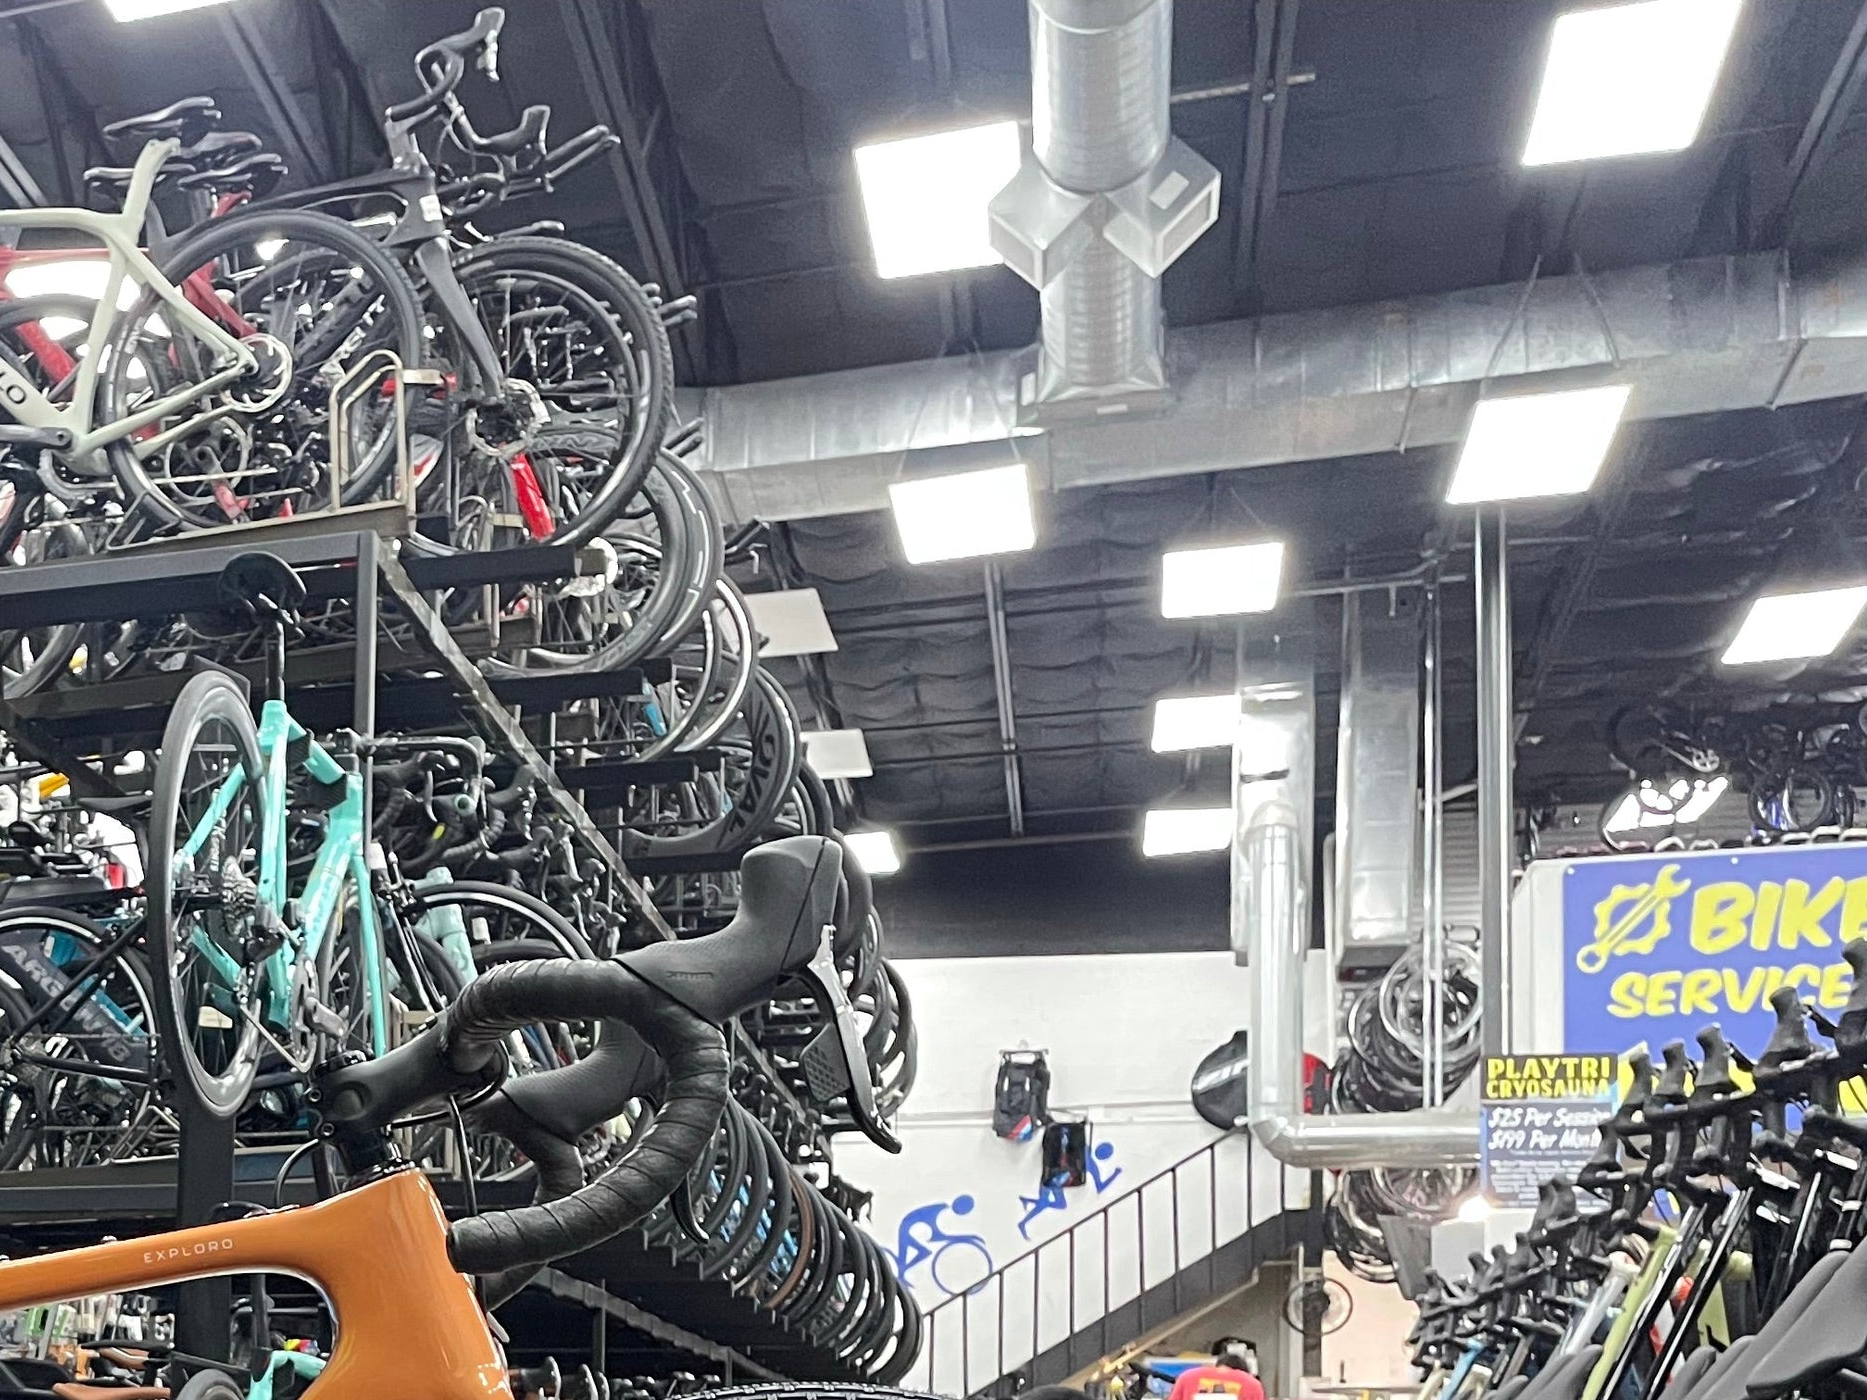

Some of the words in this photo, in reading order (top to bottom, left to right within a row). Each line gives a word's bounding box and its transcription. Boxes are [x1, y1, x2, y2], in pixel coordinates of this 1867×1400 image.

[1606, 960, 1855, 1018] SERVICE
[1487, 1057, 1610, 1079] PLAYTRI
[1486, 1078, 1610, 1098] CRYOSAUNA
[143, 1239, 233, 1263] EXPLORO
